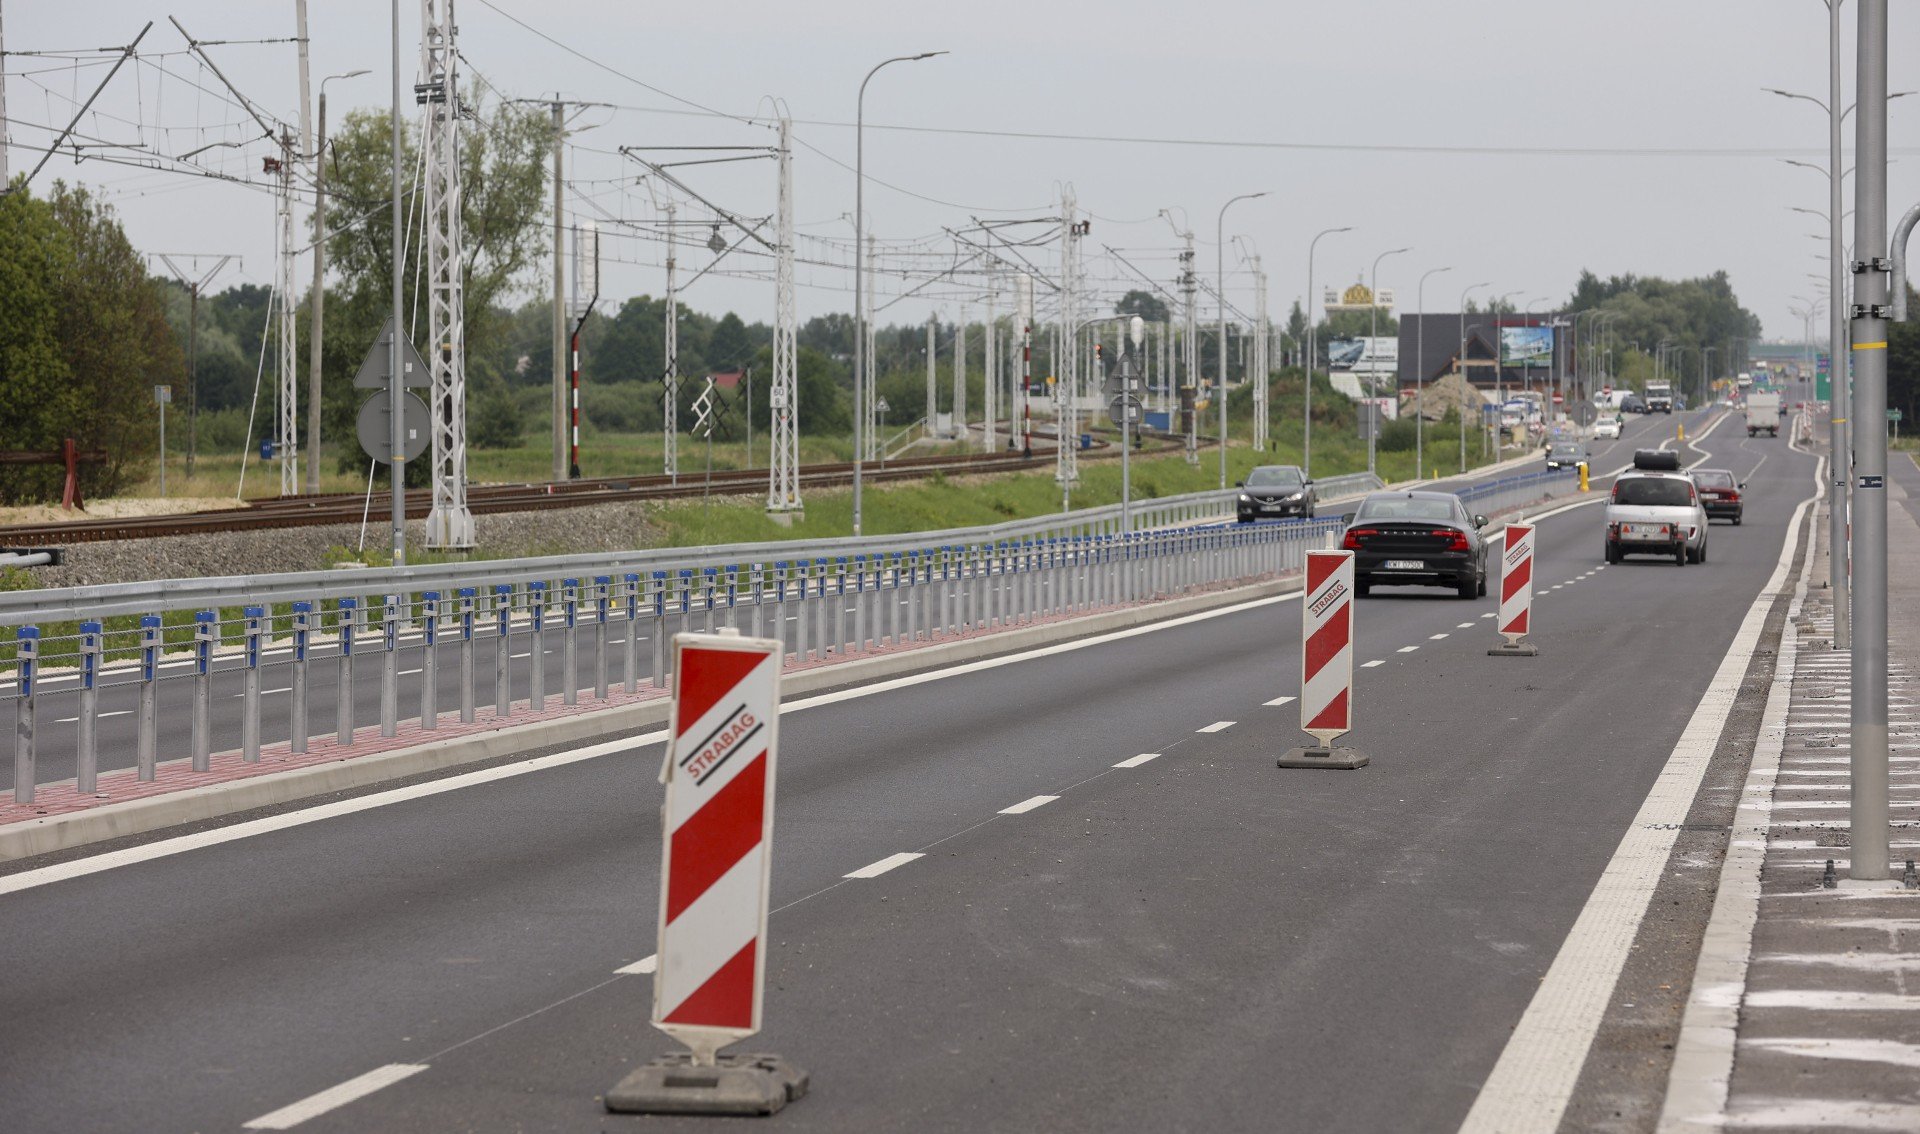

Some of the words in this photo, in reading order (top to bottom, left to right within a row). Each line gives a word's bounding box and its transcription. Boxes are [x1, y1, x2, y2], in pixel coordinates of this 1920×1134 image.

[1508, 544, 1528, 564] STRABAG
[1311, 583, 1344, 615] STRABAG
[687, 712, 755, 779] STRABAG
